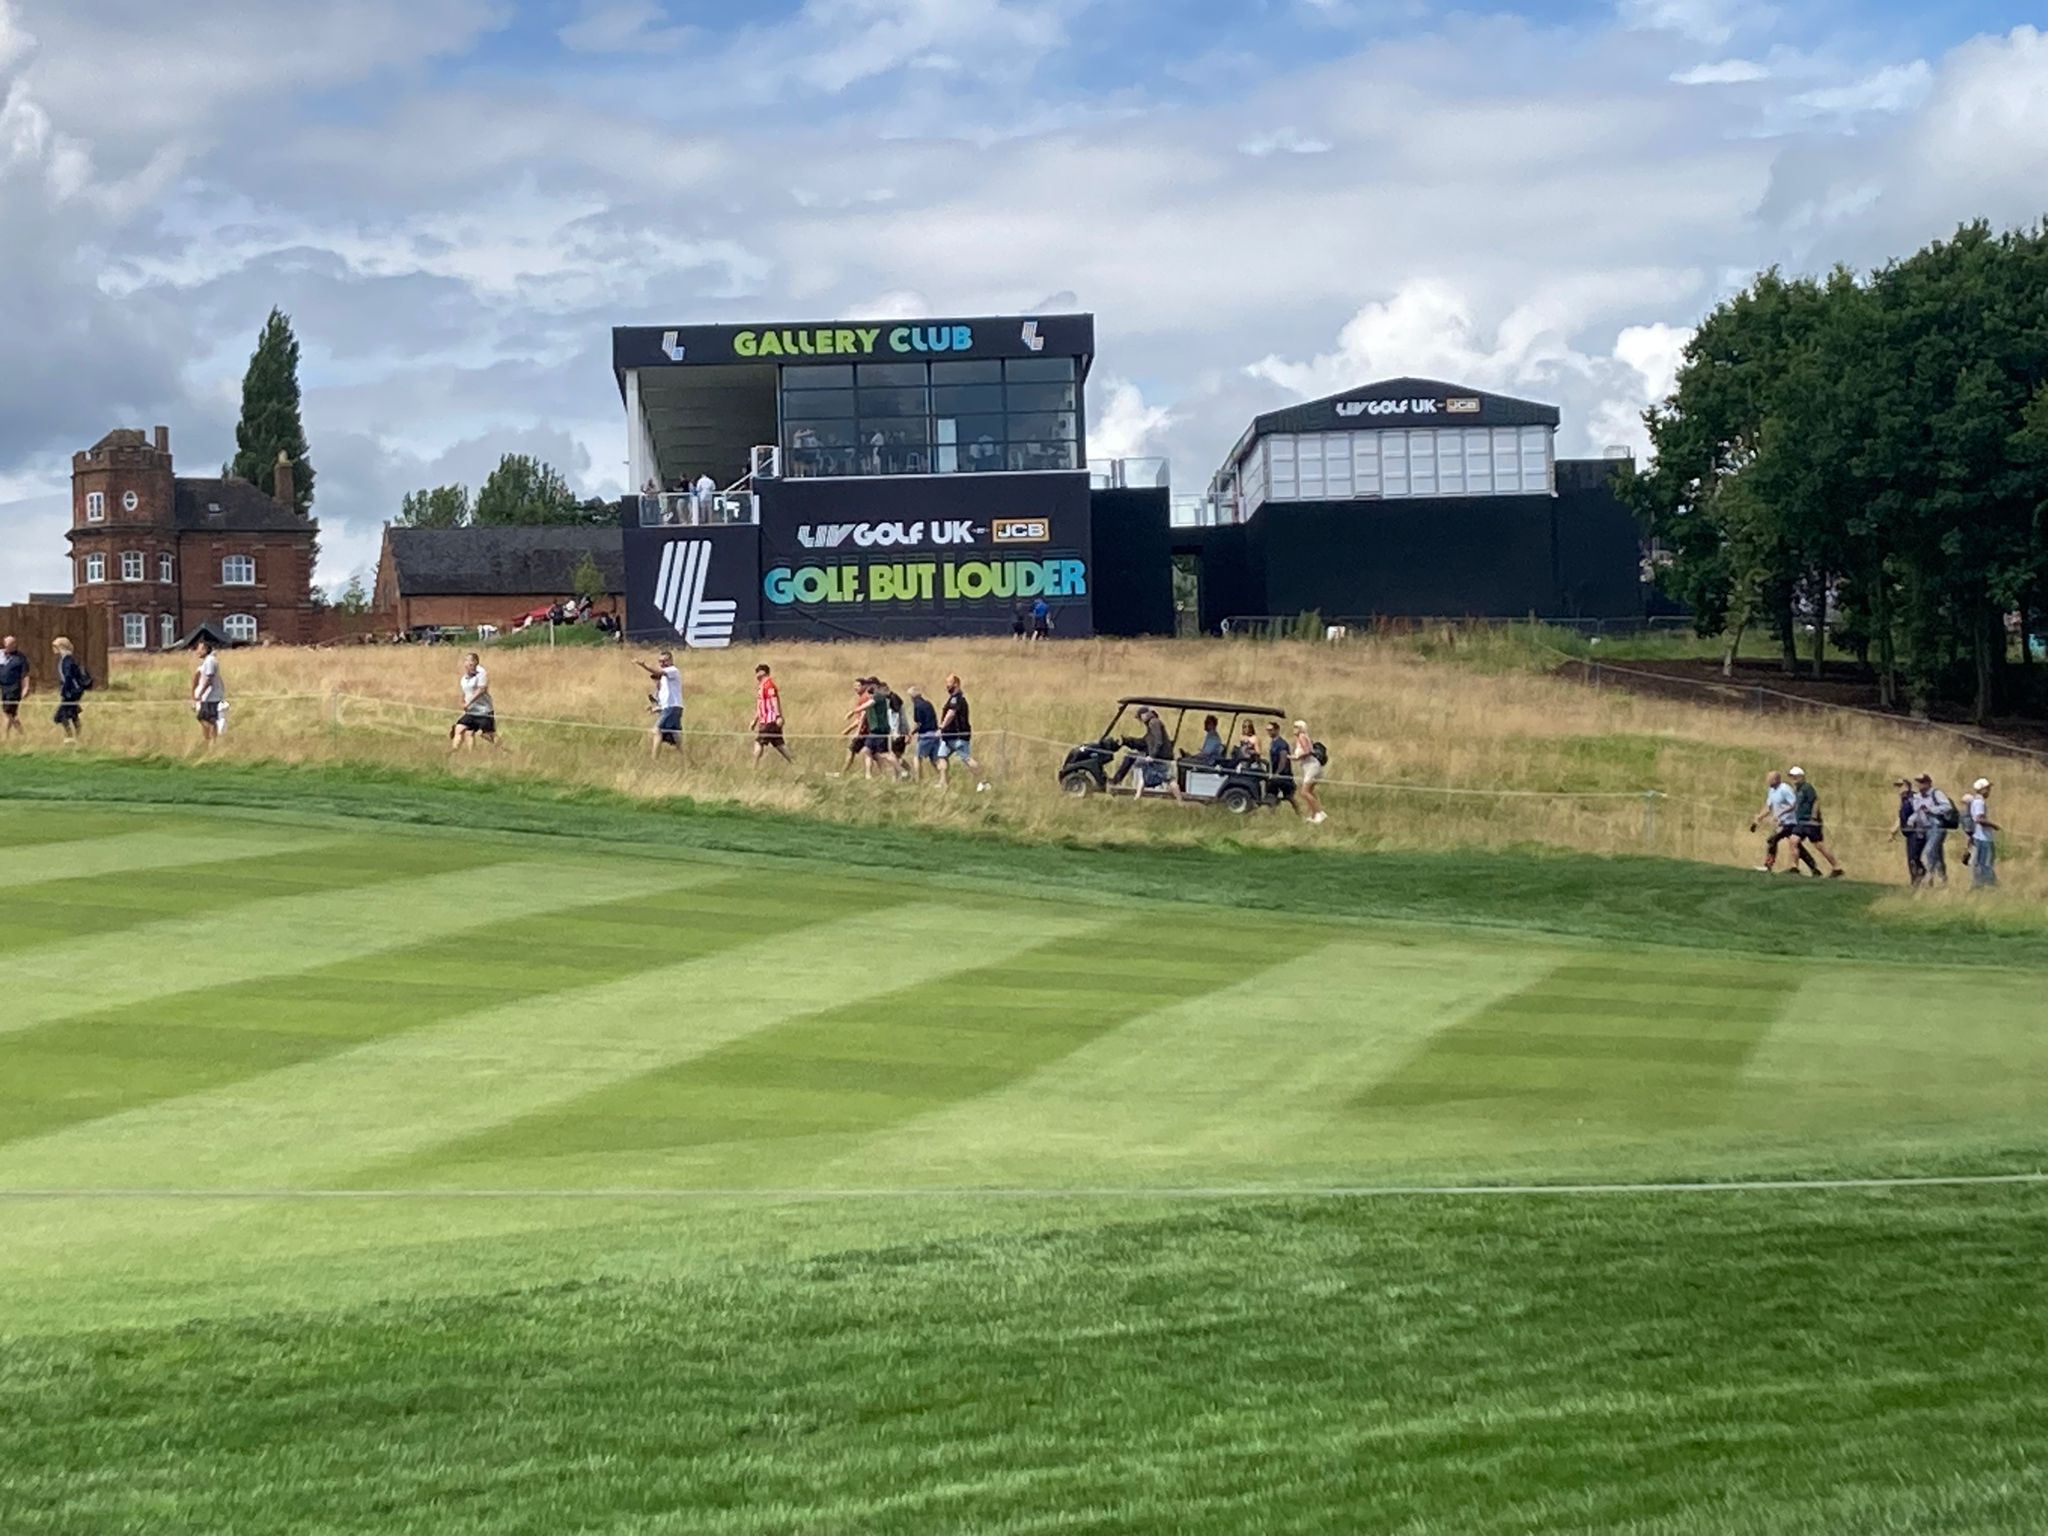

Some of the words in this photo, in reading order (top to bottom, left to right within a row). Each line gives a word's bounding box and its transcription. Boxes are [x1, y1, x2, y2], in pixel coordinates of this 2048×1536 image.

[733, 329, 880, 356] GALLERY
[888, 326, 972, 353] CLUB
[1411, 399, 1437, 413] UK
[931, 520, 975, 544] UK
[997, 523, 1045, 538] JCB
[764, 566, 863, 604] GOLF,
[868, 562, 936, 600] BUT
[944, 559, 1086, 598] LOUDER
